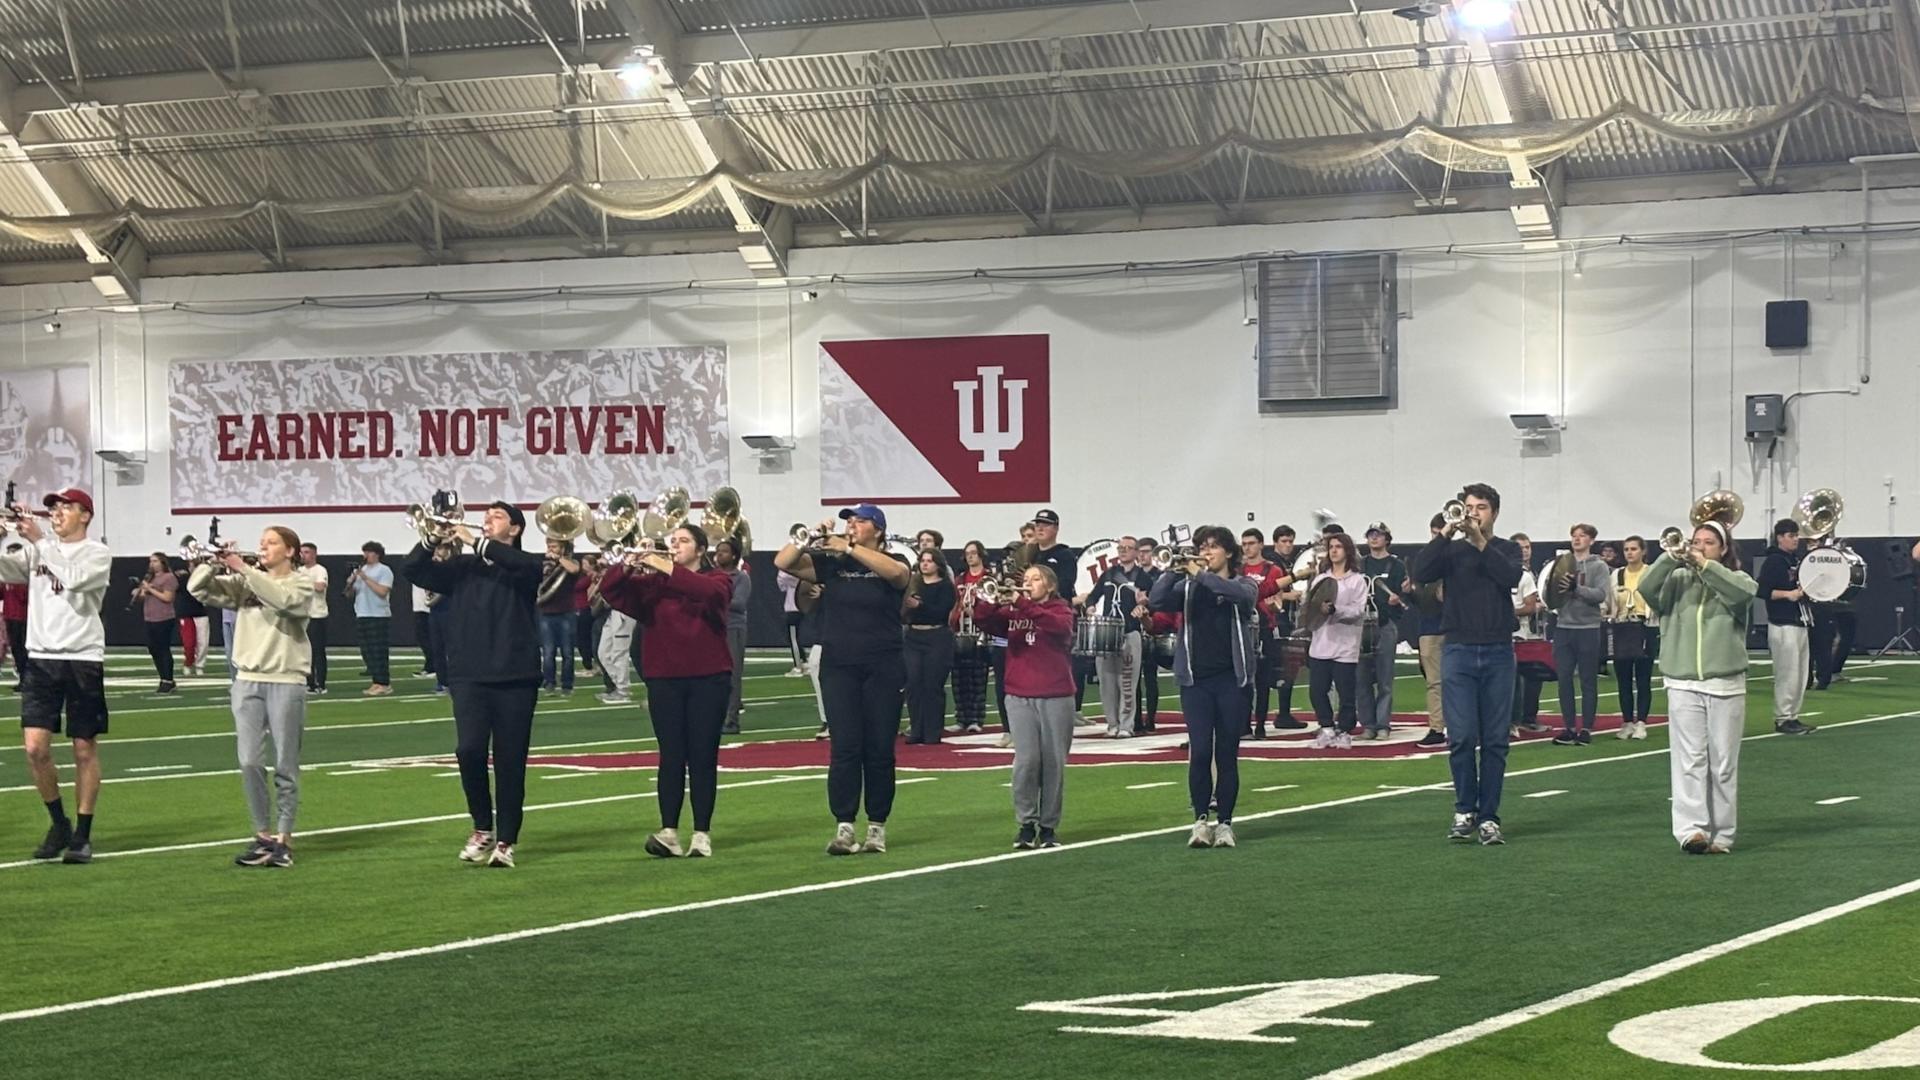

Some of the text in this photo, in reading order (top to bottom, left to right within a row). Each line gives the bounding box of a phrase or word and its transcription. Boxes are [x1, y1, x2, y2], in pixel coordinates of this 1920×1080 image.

[217, 405, 675, 461] EARNED. NOT GIVEN.
[1816, 556, 1842, 564] YAMAHA
[1008, 618, 1040, 632] INDI
